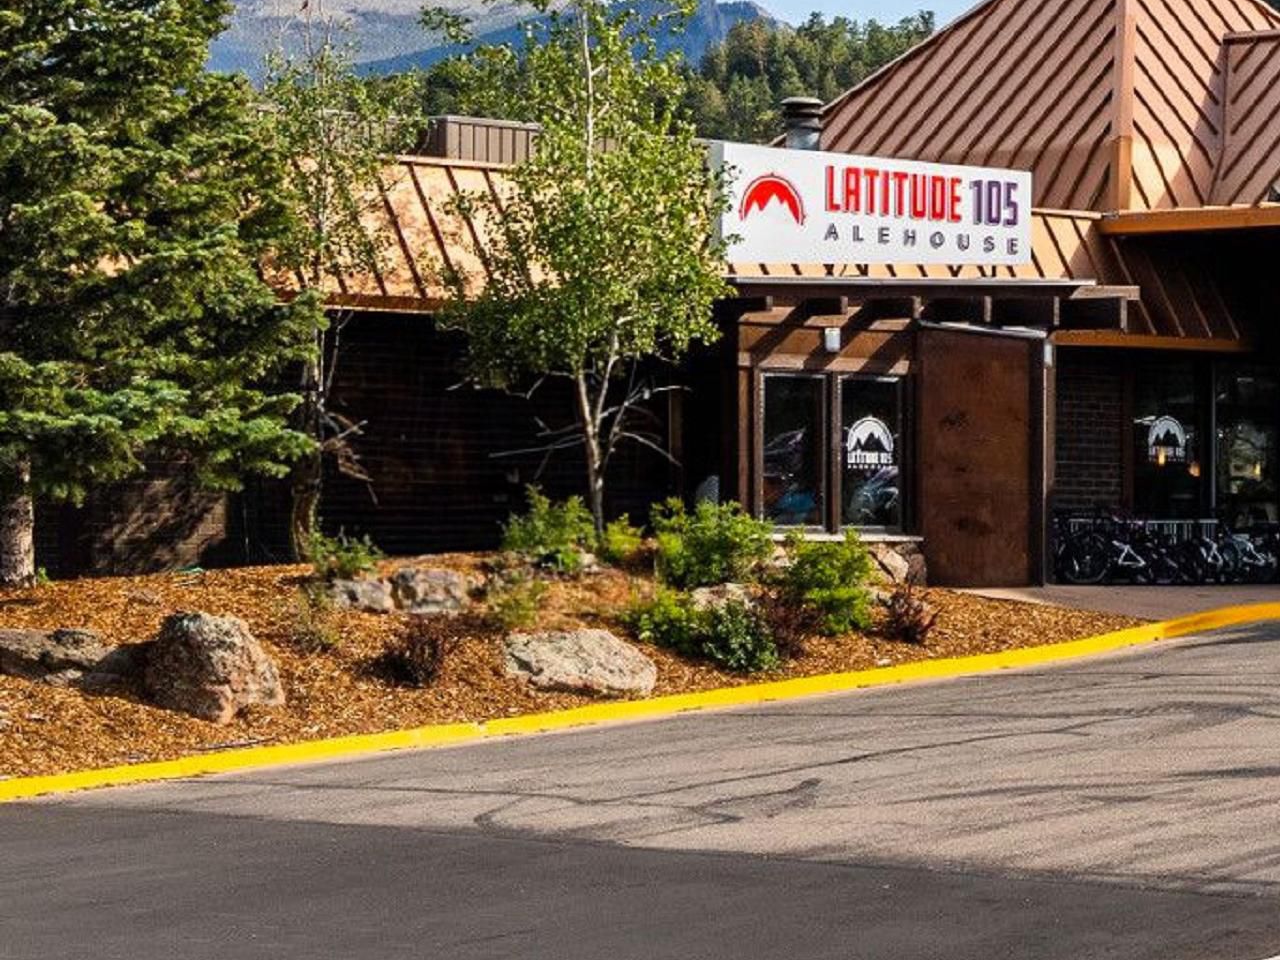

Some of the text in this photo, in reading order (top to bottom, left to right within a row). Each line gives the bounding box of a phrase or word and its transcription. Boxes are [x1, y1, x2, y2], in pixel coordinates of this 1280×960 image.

[825, 165, 1018, 227] LATITUDE 105
[825, 223, 1018, 255] ALEHOUSE
